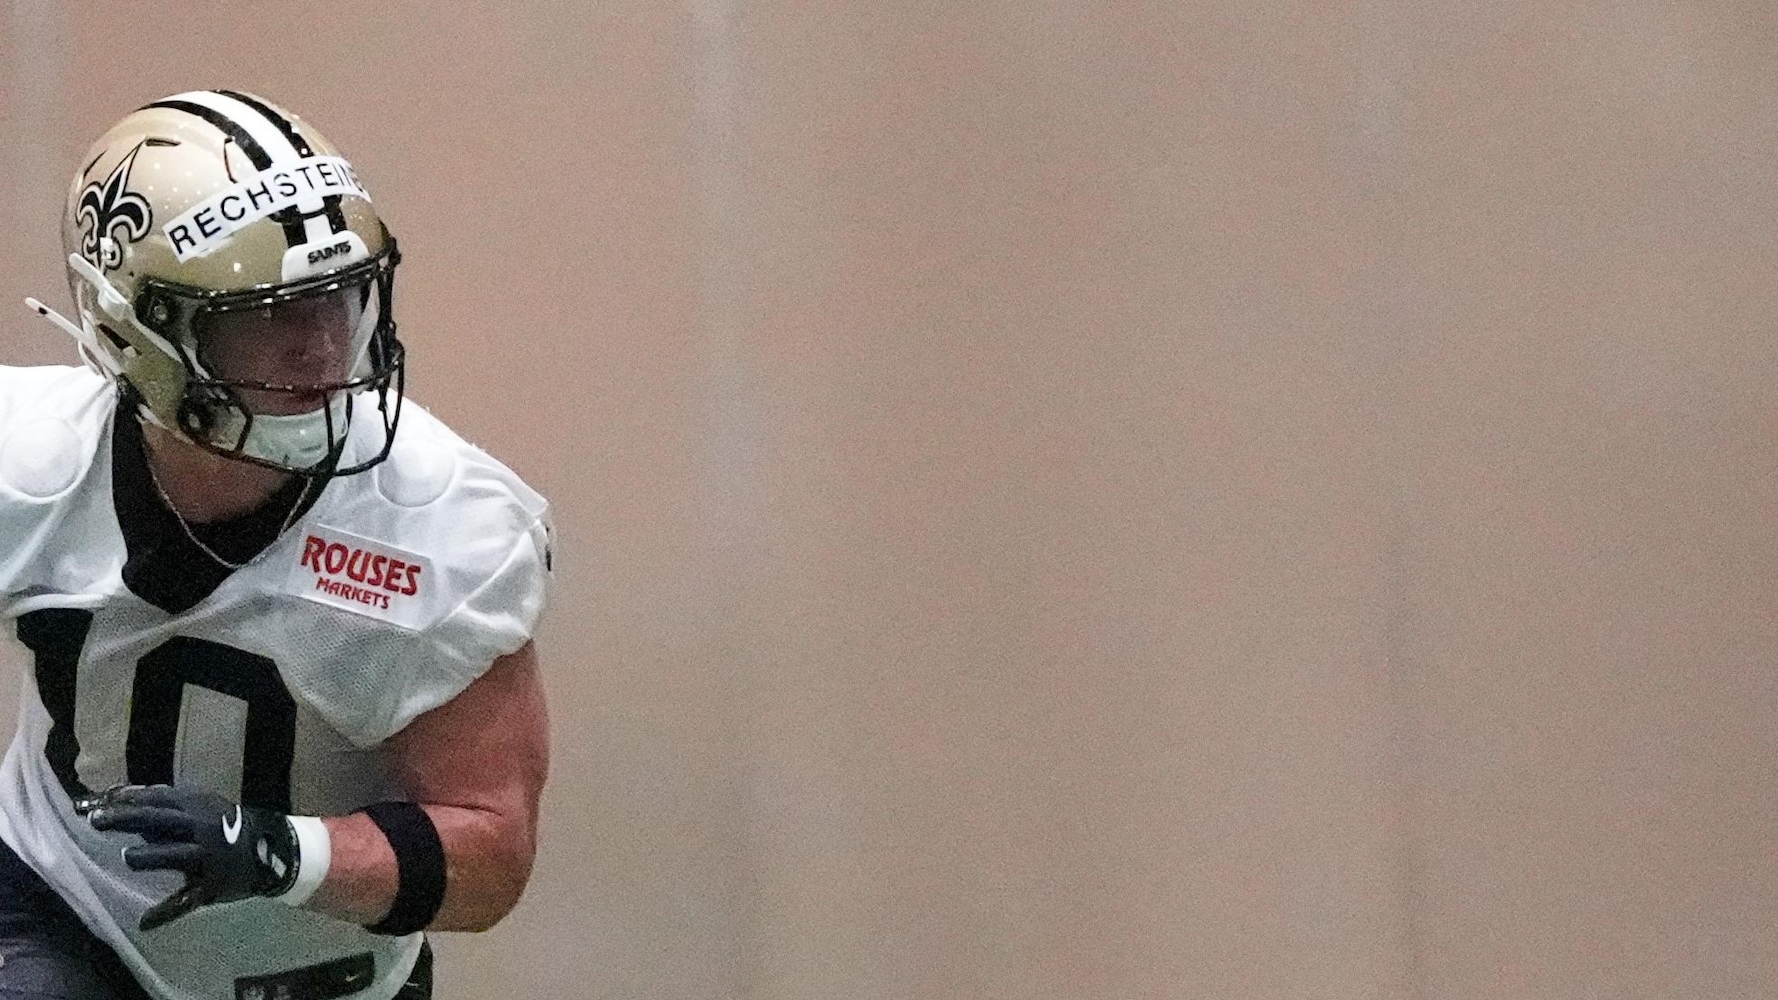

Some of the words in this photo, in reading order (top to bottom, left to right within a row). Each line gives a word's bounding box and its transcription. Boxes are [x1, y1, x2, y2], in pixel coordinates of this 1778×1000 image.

[307, 241, 352, 264] SAINTS
[301, 534, 422, 597] ROUSES
[315, 576, 391, 610] MARKETS
[16, 606, 298, 816] 10
